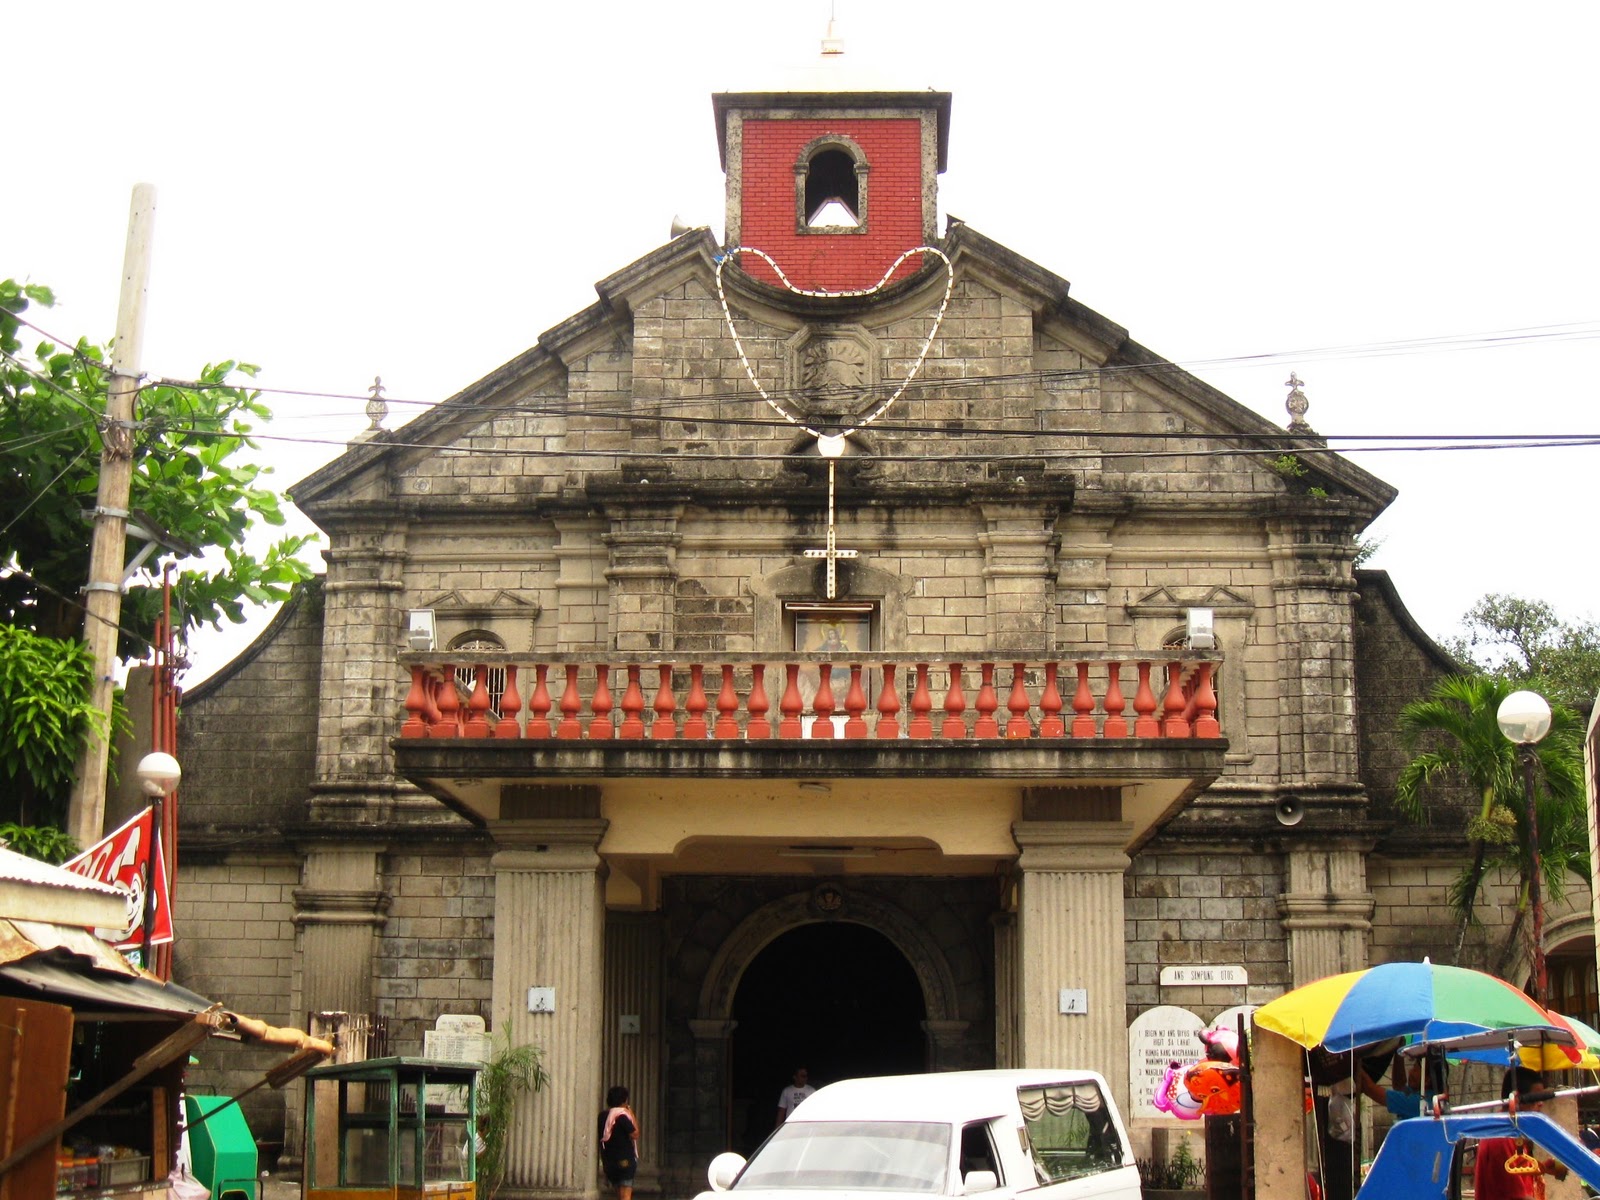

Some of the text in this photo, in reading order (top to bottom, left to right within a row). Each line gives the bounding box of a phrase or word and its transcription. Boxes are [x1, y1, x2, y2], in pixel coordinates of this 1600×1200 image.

[1174, 970, 1234, 981] ANG SAMPUNG UTOS
[1167, 1029, 1176, 1038] ANG
[1167, 1038, 1174, 1047] SA
